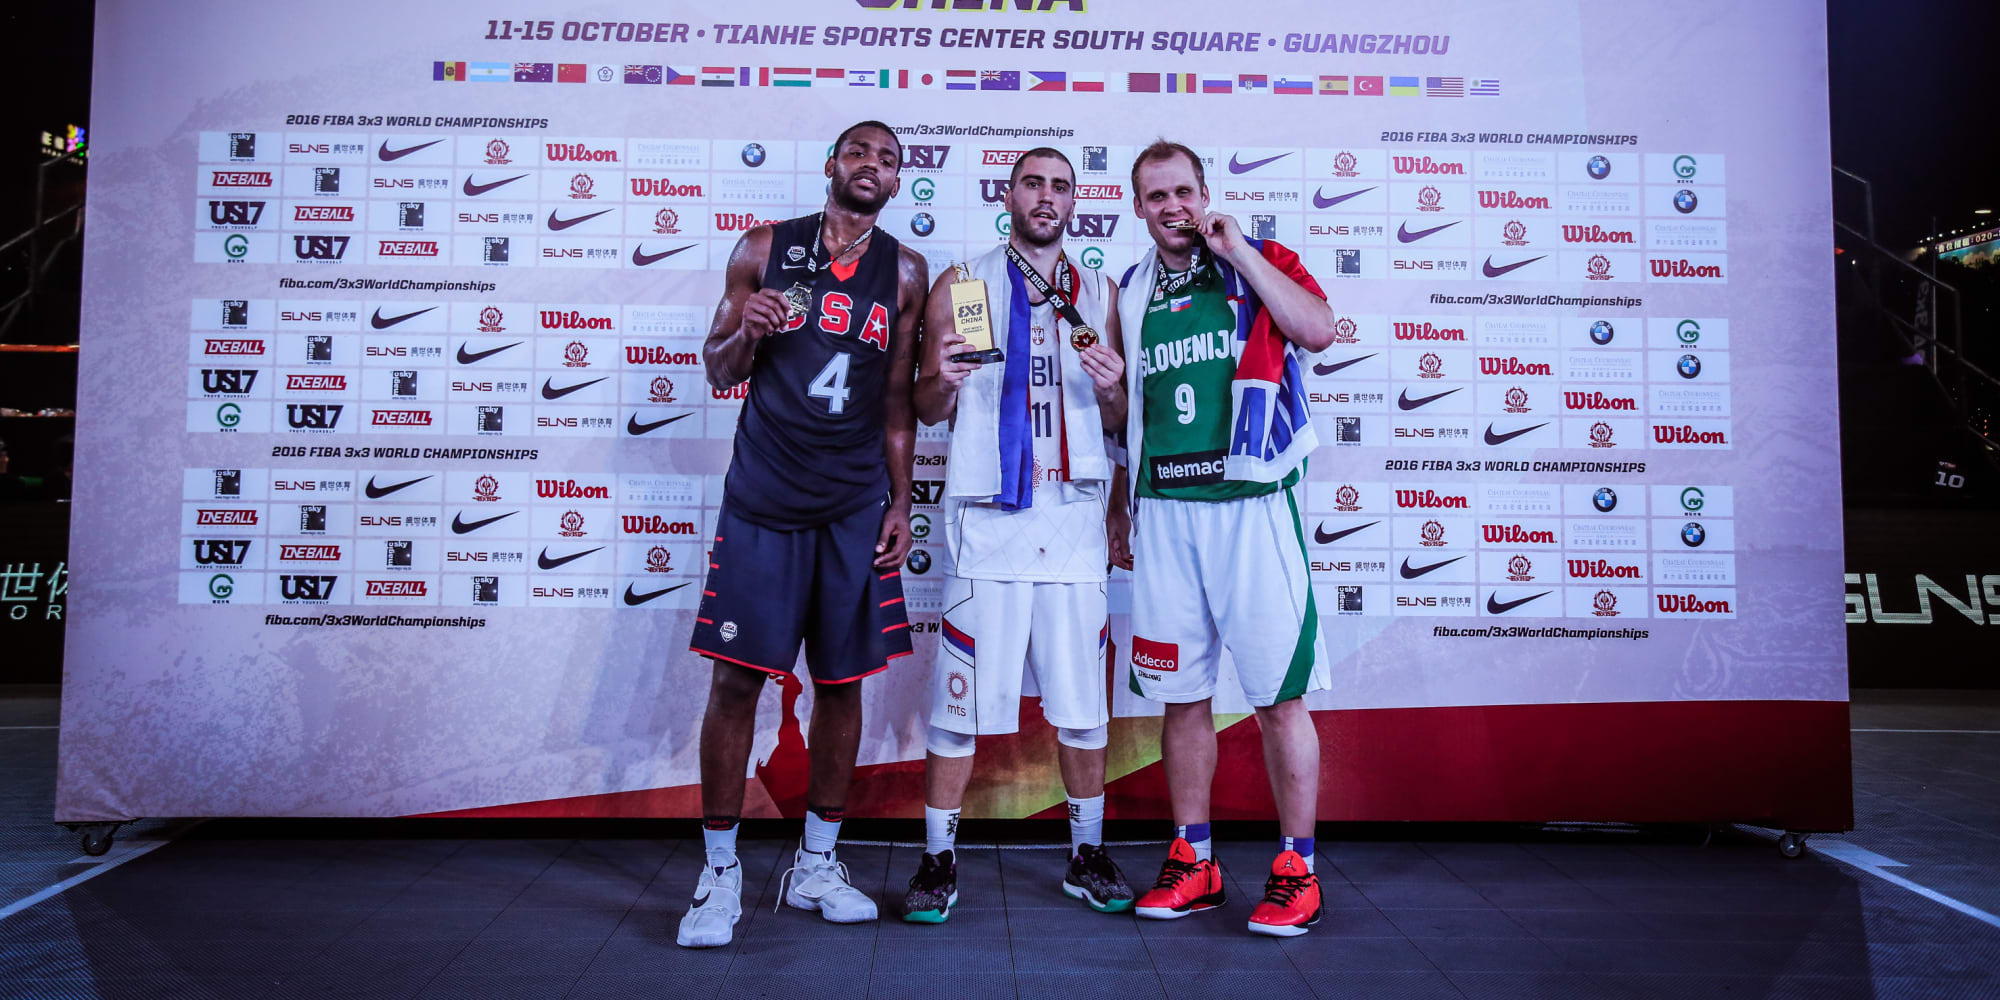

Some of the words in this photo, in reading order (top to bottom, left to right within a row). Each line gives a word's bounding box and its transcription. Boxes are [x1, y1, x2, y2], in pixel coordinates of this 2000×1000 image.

[485, 20, 555, 40] 11-15
[562, 22, 689, 43] OCTOBER
[714, 24, 816, 45] TIANHE
[823, 26, 932, 47] SPORTS
[940, 28, 1045, 48] CENTER
[1053, 30, 1144, 50] SOUTH
[1152, 32, 1261, 52] SQUARE
[1284, 34, 1449, 54] GUANGZHOU
[286, 115, 320, 125] 2016
[323, 115, 354, 125] FIBA
[357, 116, 383, 126] 3x3
[387, 116, 431, 126] WORLD
[435, 117, 548, 128] CHAMPIONSHIPS
[890, 124, 1074, 138] om/3x3WorldChampionships
[1381, 132, 1413, 141] 2016
[1417, 132, 1447, 142] FIBA
[1451, 133, 1475, 142] 3x3
[1479, 133, 1523, 143] WORLD
[1527, 134, 1638, 145] CHAMPIONSHIPS
[290, 144, 329, 153] SLNS
[546, 144, 618, 162] Wilson
[1393, 156, 1464, 174] Wilson
[374, 179, 413, 188] SLNS
[631, 178, 702, 197] Wilson
[1226, 192, 1264, 200] SLNS
[1478, 191, 1552, 209] Wilson
[459, 214, 498, 222] SLNS
[1310, 226, 1349, 235] SLNS
[1562, 225, 1633, 243] Wilson
[543, 249, 582, 257] SLNS
[1394, 261, 1433, 269] SLNS
[1650, 260, 1723, 277] Wilson
[280, 278, 496, 293] fiba.com/3x3WorldChampionships
[1431, 293, 1642, 309] fiba.com/3x3WorldChampionships
[282, 312, 321, 321] SLNS
[540, 311, 612, 329] Wilson
[776, 291, 890, 352] SA
[961, 316, 983, 325] CHINA
[1393, 323, 1465, 341] Wilson
[367, 347, 406, 356] SLNS
[626, 346, 698, 365] Wilson
[1479, 357, 1551, 375] Wilson
[452, 382, 492, 391] SLNS
[808, 352, 850, 414] 4
[1175, 383, 1196, 425] 9
[1310, 393, 1349, 402] SLNS
[1564, 392, 1636, 410] Wilson
[538, 418, 577, 427] SLNS
[1032, 402, 1051, 438] 11
[1395, 428, 1434, 437] SLNS
[1653, 425, 1728, 444] Wilson
[272, 447, 306, 457] 2016
[310, 447, 341, 457] FIBA
[345, 448, 370, 457] 3x3
[374, 448, 420, 458] WORLD
[423, 448, 538, 459] CHAMPIONSHIPS
[1385, 460, 1418, 470] 2016
[1422, 461, 1452, 470] FIBA
[1456, 461, 1481, 471] 3x3
[1485, 461, 1529, 471] WORLD
[1533, 462, 1646, 472] CHAMPIONSHIPS
[275, 481, 315, 490] SLNS
[1935, 471, 1964, 489] 10
[536, 480, 608, 498] Wilson
[912, 481, 945, 504] S17
[1396, 490, 1467, 508] Wilson
[361, 517, 401, 526] SLNS
[622, 516, 697, 534] Wilson
[1482, 525, 1557, 543] Wilson
[448, 552, 487, 561] SLNS
[1311, 562, 1350, 571] SLNS
[1568, 560, 1640, 578] Wilson
[533, 588, 573, 597] SLNS
[1397, 597, 1436, 606] SLNS
[1657, 594, 1732, 613] Wilson
[265, 614, 485, 629] fiba.com/3x3WorldChampionships
[1434, 626, 1649, 640] fiba.com/3x3WorldChampionships
[1134, 651, 1175, 669] Adecco
[948, 704, 967, 717] mts
